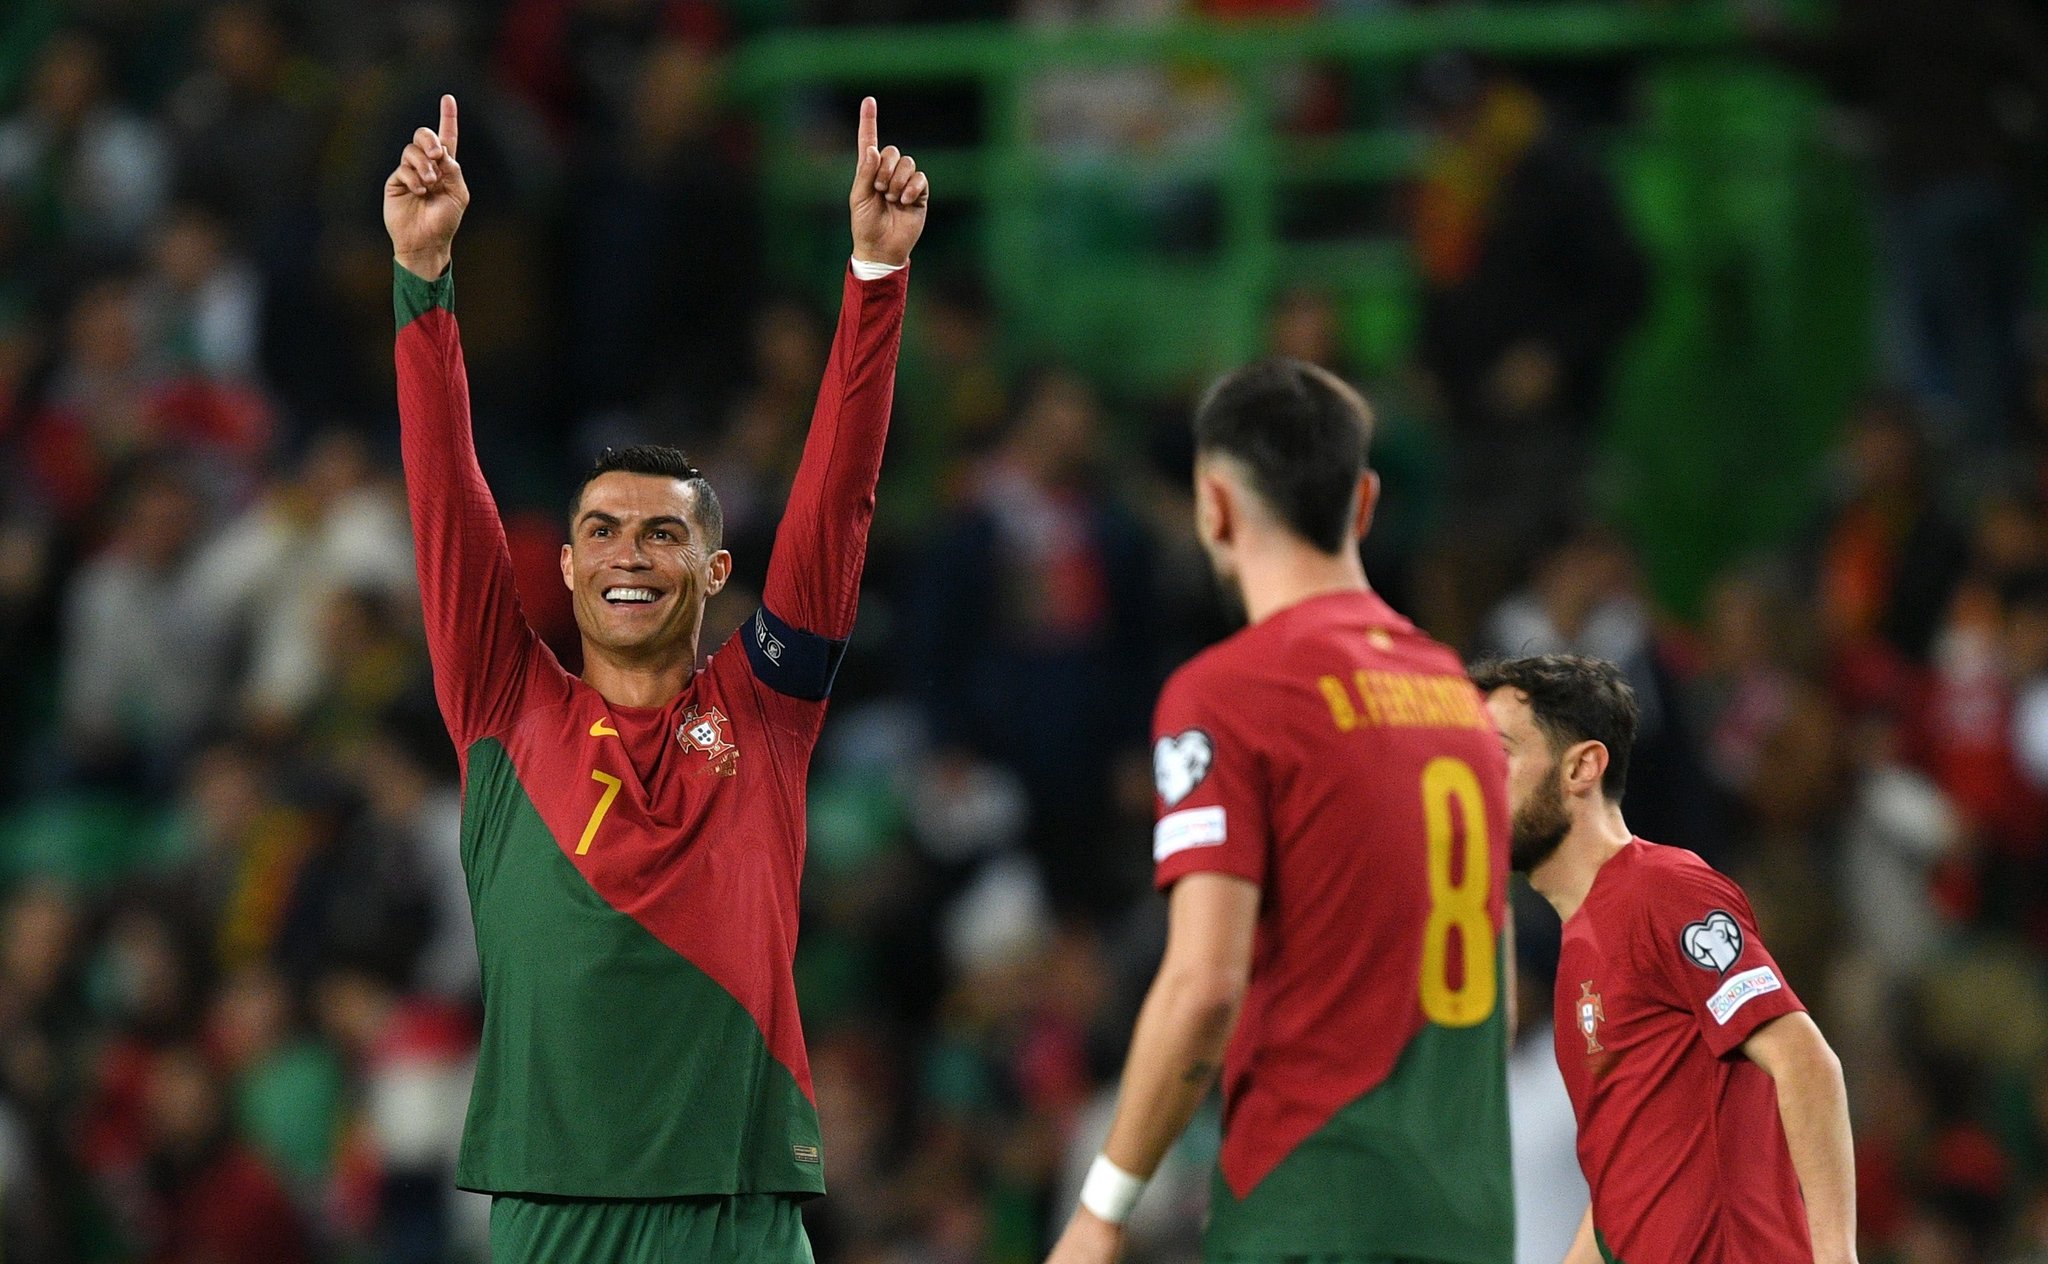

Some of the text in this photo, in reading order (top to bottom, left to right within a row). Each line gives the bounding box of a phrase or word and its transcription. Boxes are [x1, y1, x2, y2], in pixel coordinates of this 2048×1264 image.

[574, 769, 622, 856] 7
[1419, 757, 1498, 1028] 8
[1713, 974, 1774, 1015] FOUNDATION
